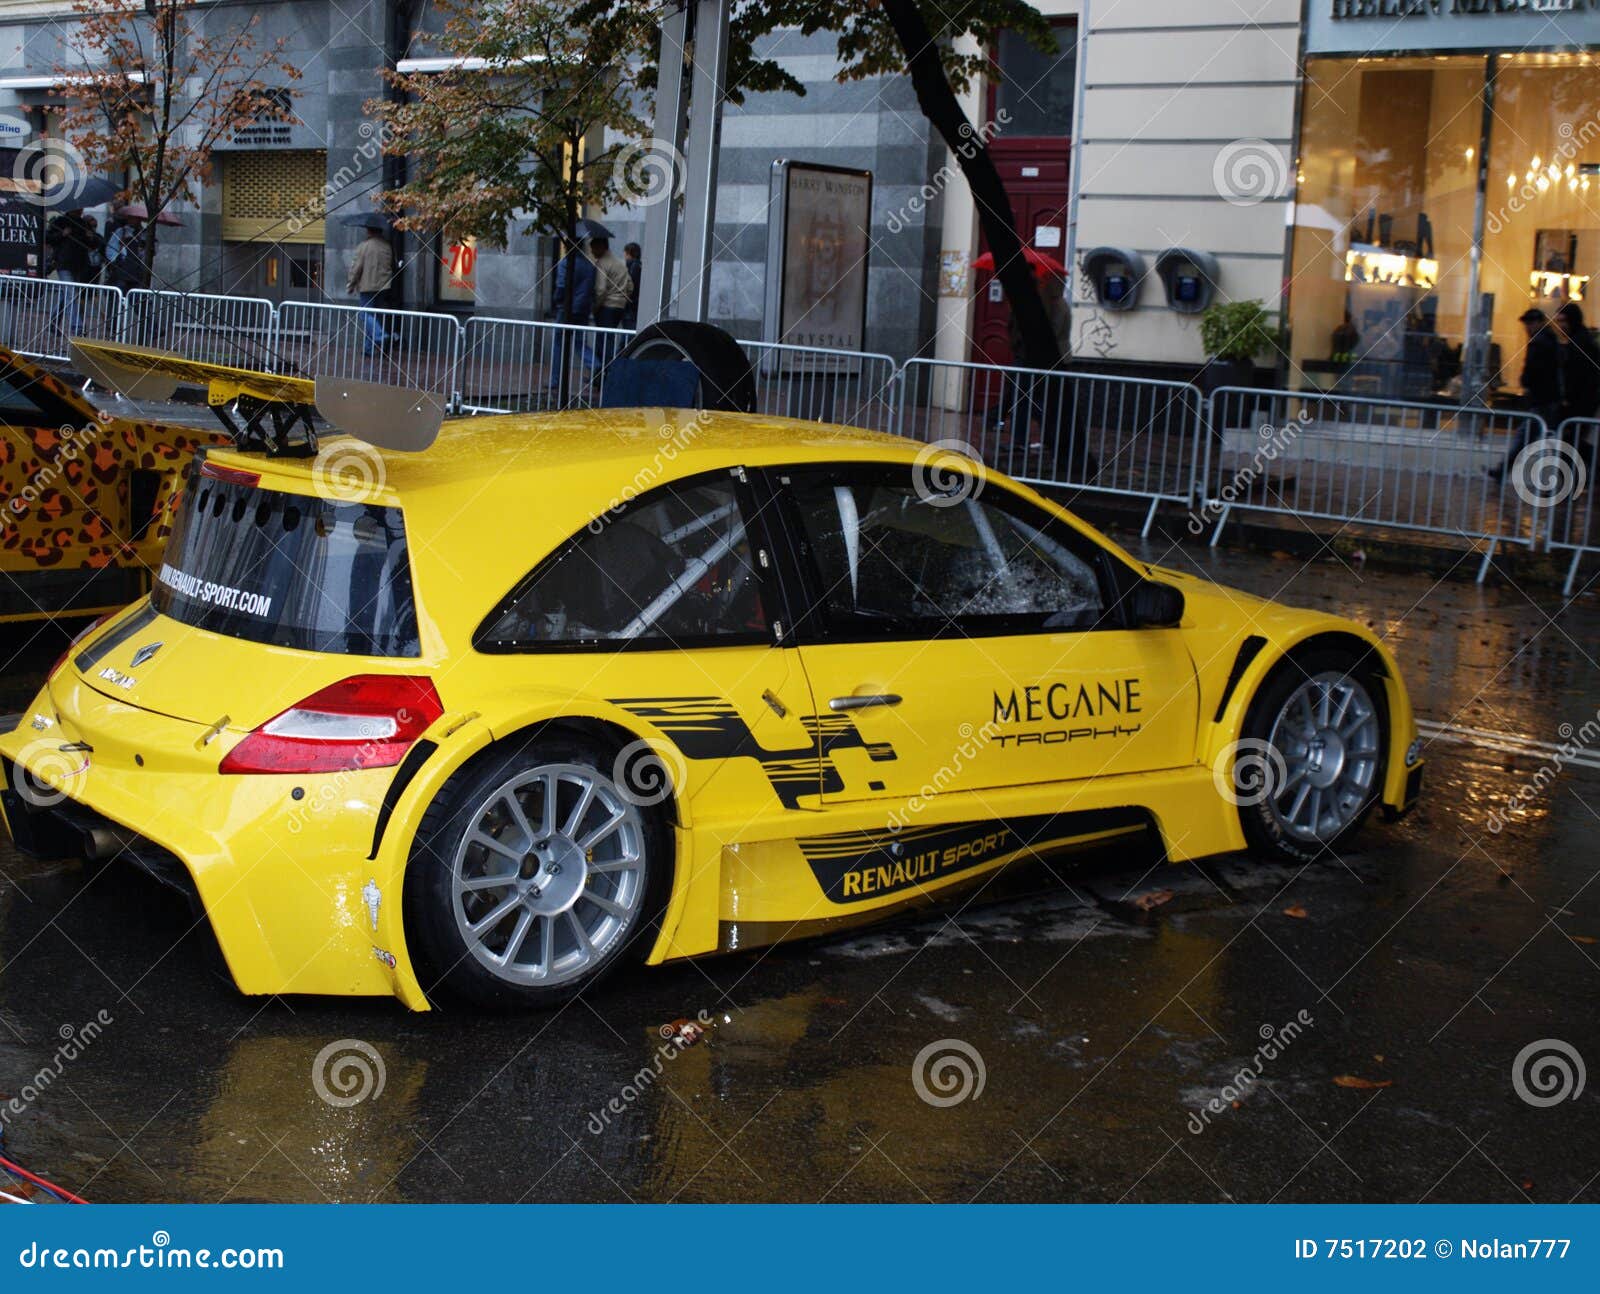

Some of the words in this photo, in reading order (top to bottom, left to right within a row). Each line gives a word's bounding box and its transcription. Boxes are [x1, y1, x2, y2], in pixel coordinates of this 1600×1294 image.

[1, 228, 36, 244] LERA
[993, 678, 1142, 724] MEGANE
[991, 724, 1141, 748] TROPHY
[843, 850, 941, 897] RENAULT
[941, 829, 1012, 868] SPORT
